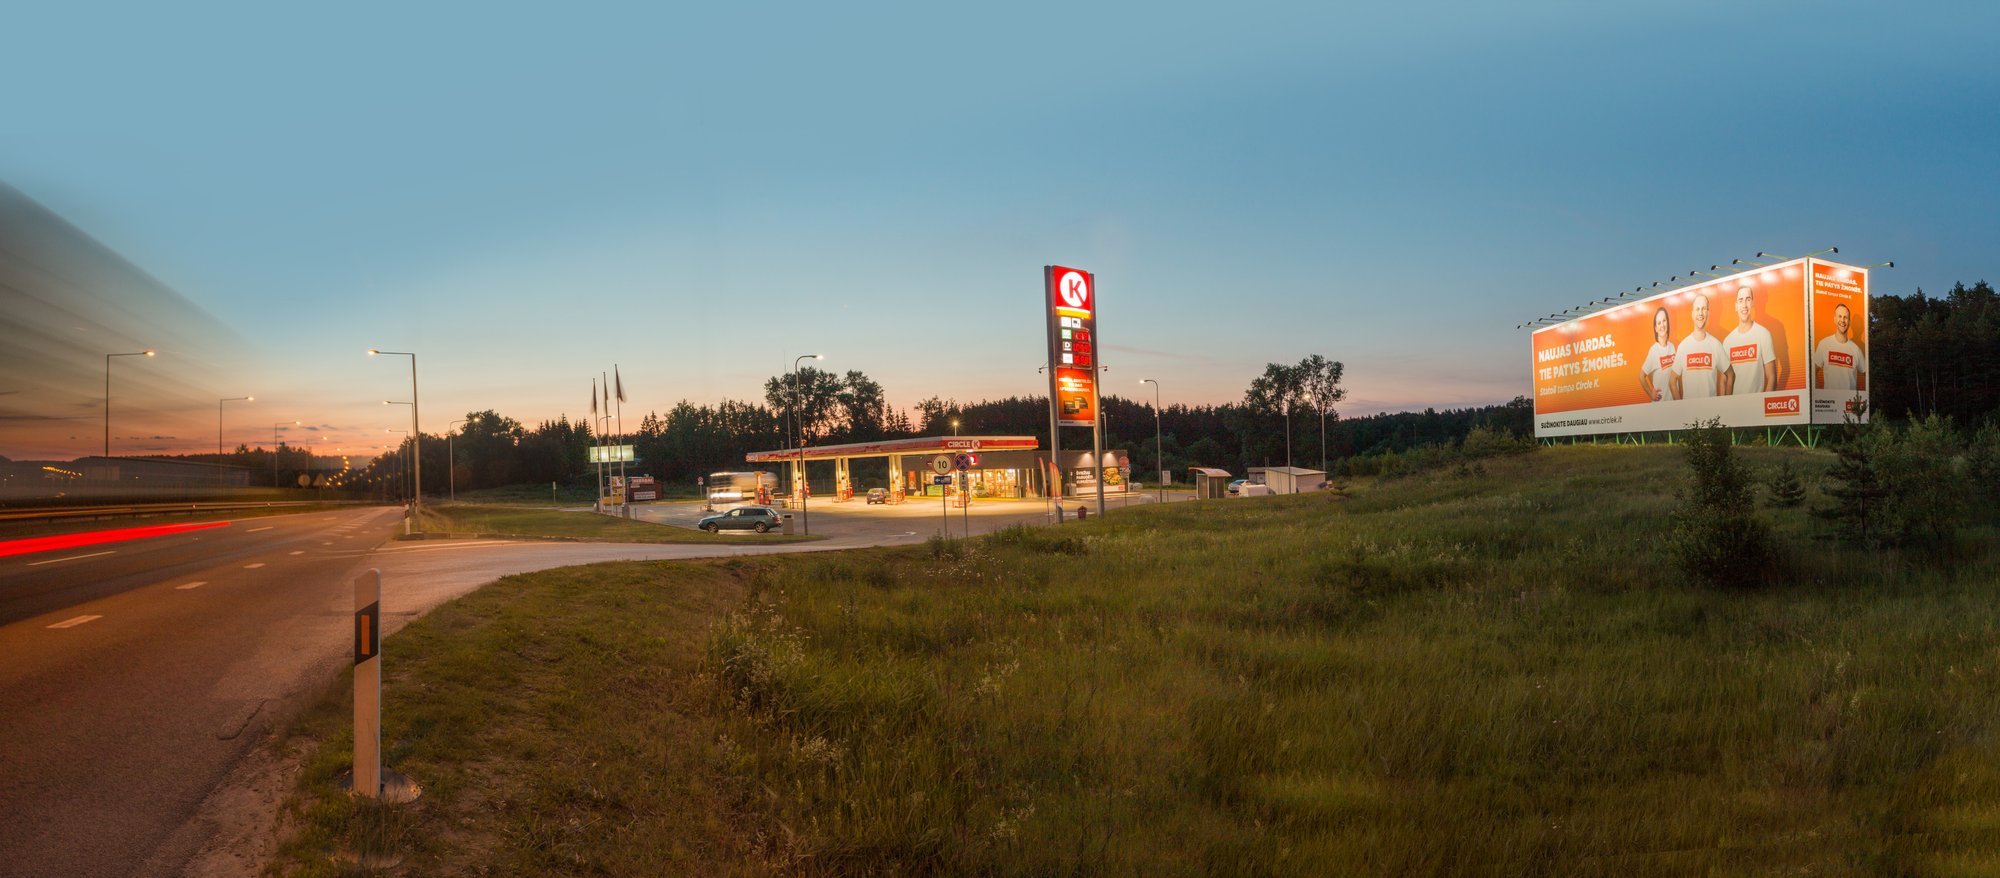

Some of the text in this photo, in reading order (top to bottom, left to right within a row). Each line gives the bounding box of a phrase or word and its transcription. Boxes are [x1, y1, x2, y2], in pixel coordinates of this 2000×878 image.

[1538, 333, 1616, 363] NAUJAS VARDAS.
[1731, 350, 1747, 358] CIRCLE
[1539, 351, 1628, 381] TIE PATYS ŽMONĖS.
[1576, 379, 1593, 390] Circle
[1767, 401, 1788, 410] CIRCLE
[1541, 420, 1566, 429] SUŽINOKITE
[1567, 418, 1588, 427] DAUGIAU
[937, 460, 948, 469] 10
